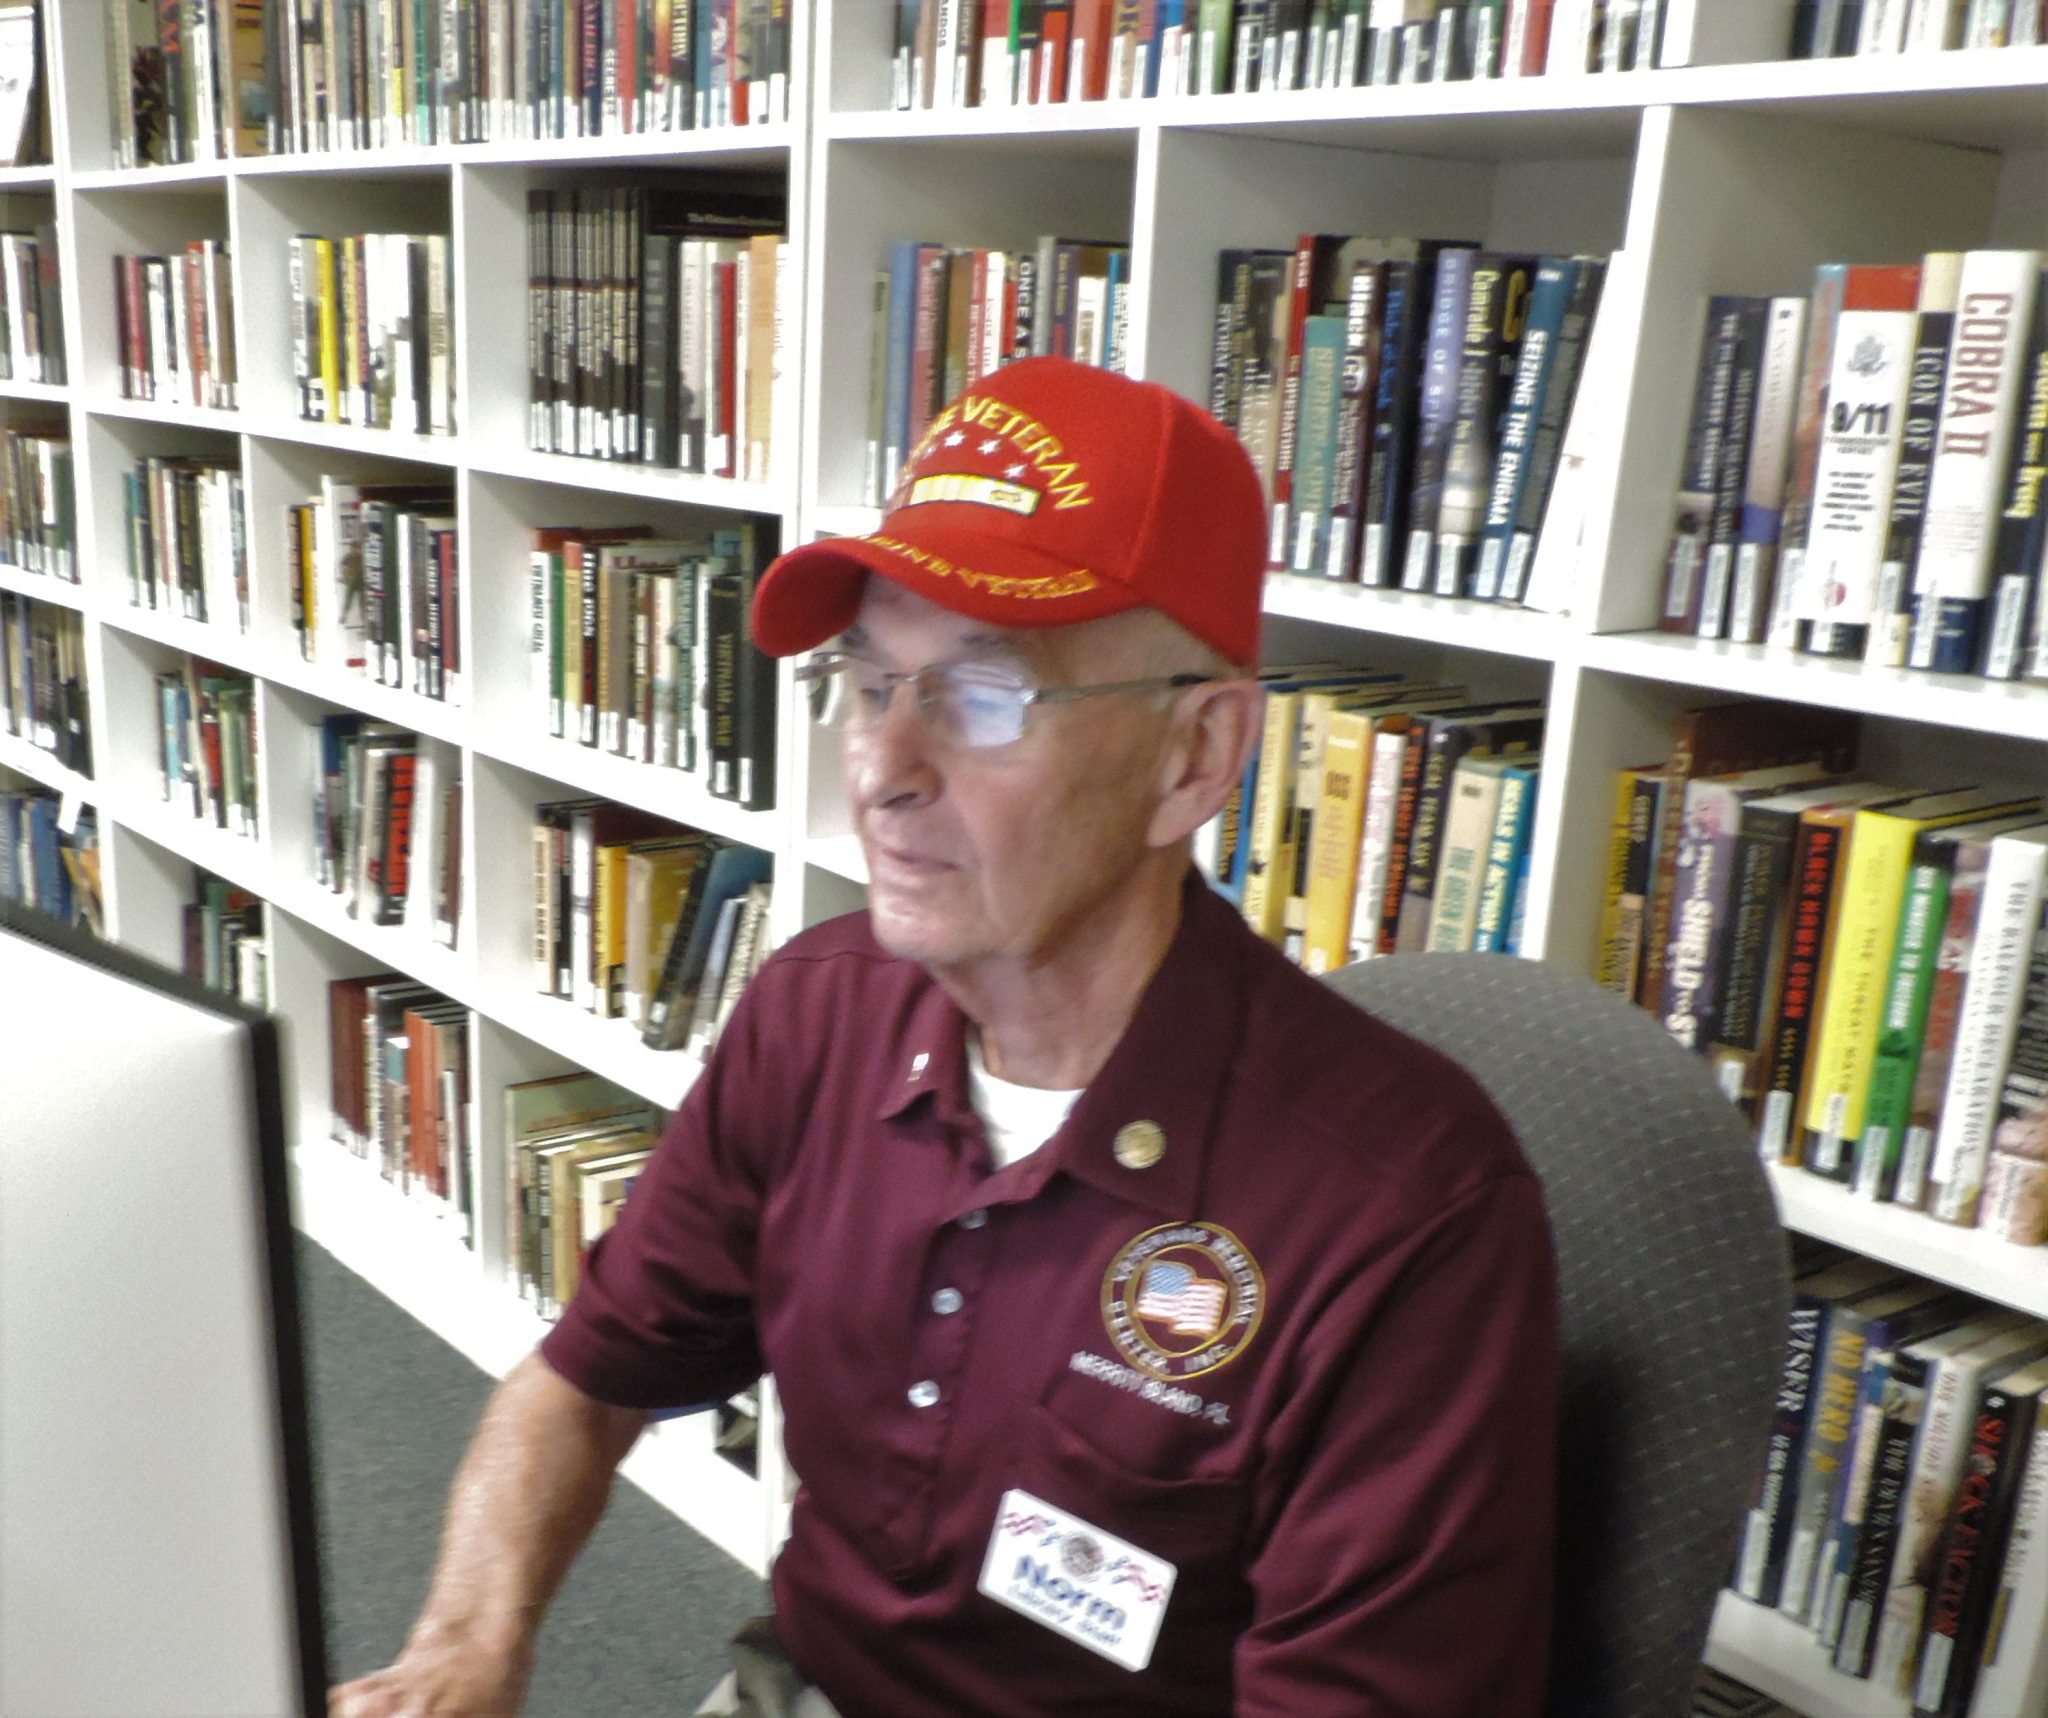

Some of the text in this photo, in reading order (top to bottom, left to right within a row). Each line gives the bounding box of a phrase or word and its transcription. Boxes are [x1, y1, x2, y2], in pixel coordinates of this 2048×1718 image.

[1015, 261, 1031, 317] ONCE
[1463, 271, 1500, 342] Comrade
[1212, 302, 1233, 368] STORM
[1423, 259, 1457, 447] BRIDGE OF SPIES
[1941, 291, 2012, 456] COBRA II
[963, 395, 1094, 509] VETERAN
[1278, 376, 1298, 469] OPERATORS
[1487, 330, 1549, 525] SEIZING THE ENIGMA
[1831, 401, 1891, 434] 9/11
[1890, 347, 1946, 521] ICON OF EVIL
[716, 633, 734, 703] VIETNAM
[1490, 842, 1512, 860] IN
[1474, 865, 1507, 929] ACTION
[1783, 834, 1830, 1016] BLACK HAWK DOWN
[2006, 882, 2031, 915] THE
[1672, 900, 1712, 985] SHIELD
[1959, 1024, 2002, 1147] DECLARATION
[1773, 1309, 1820, 1409] WISER
[1818, 1330, 1864, 1442] NO HERO
[1013, 1554, 1127, 1628] Norm
